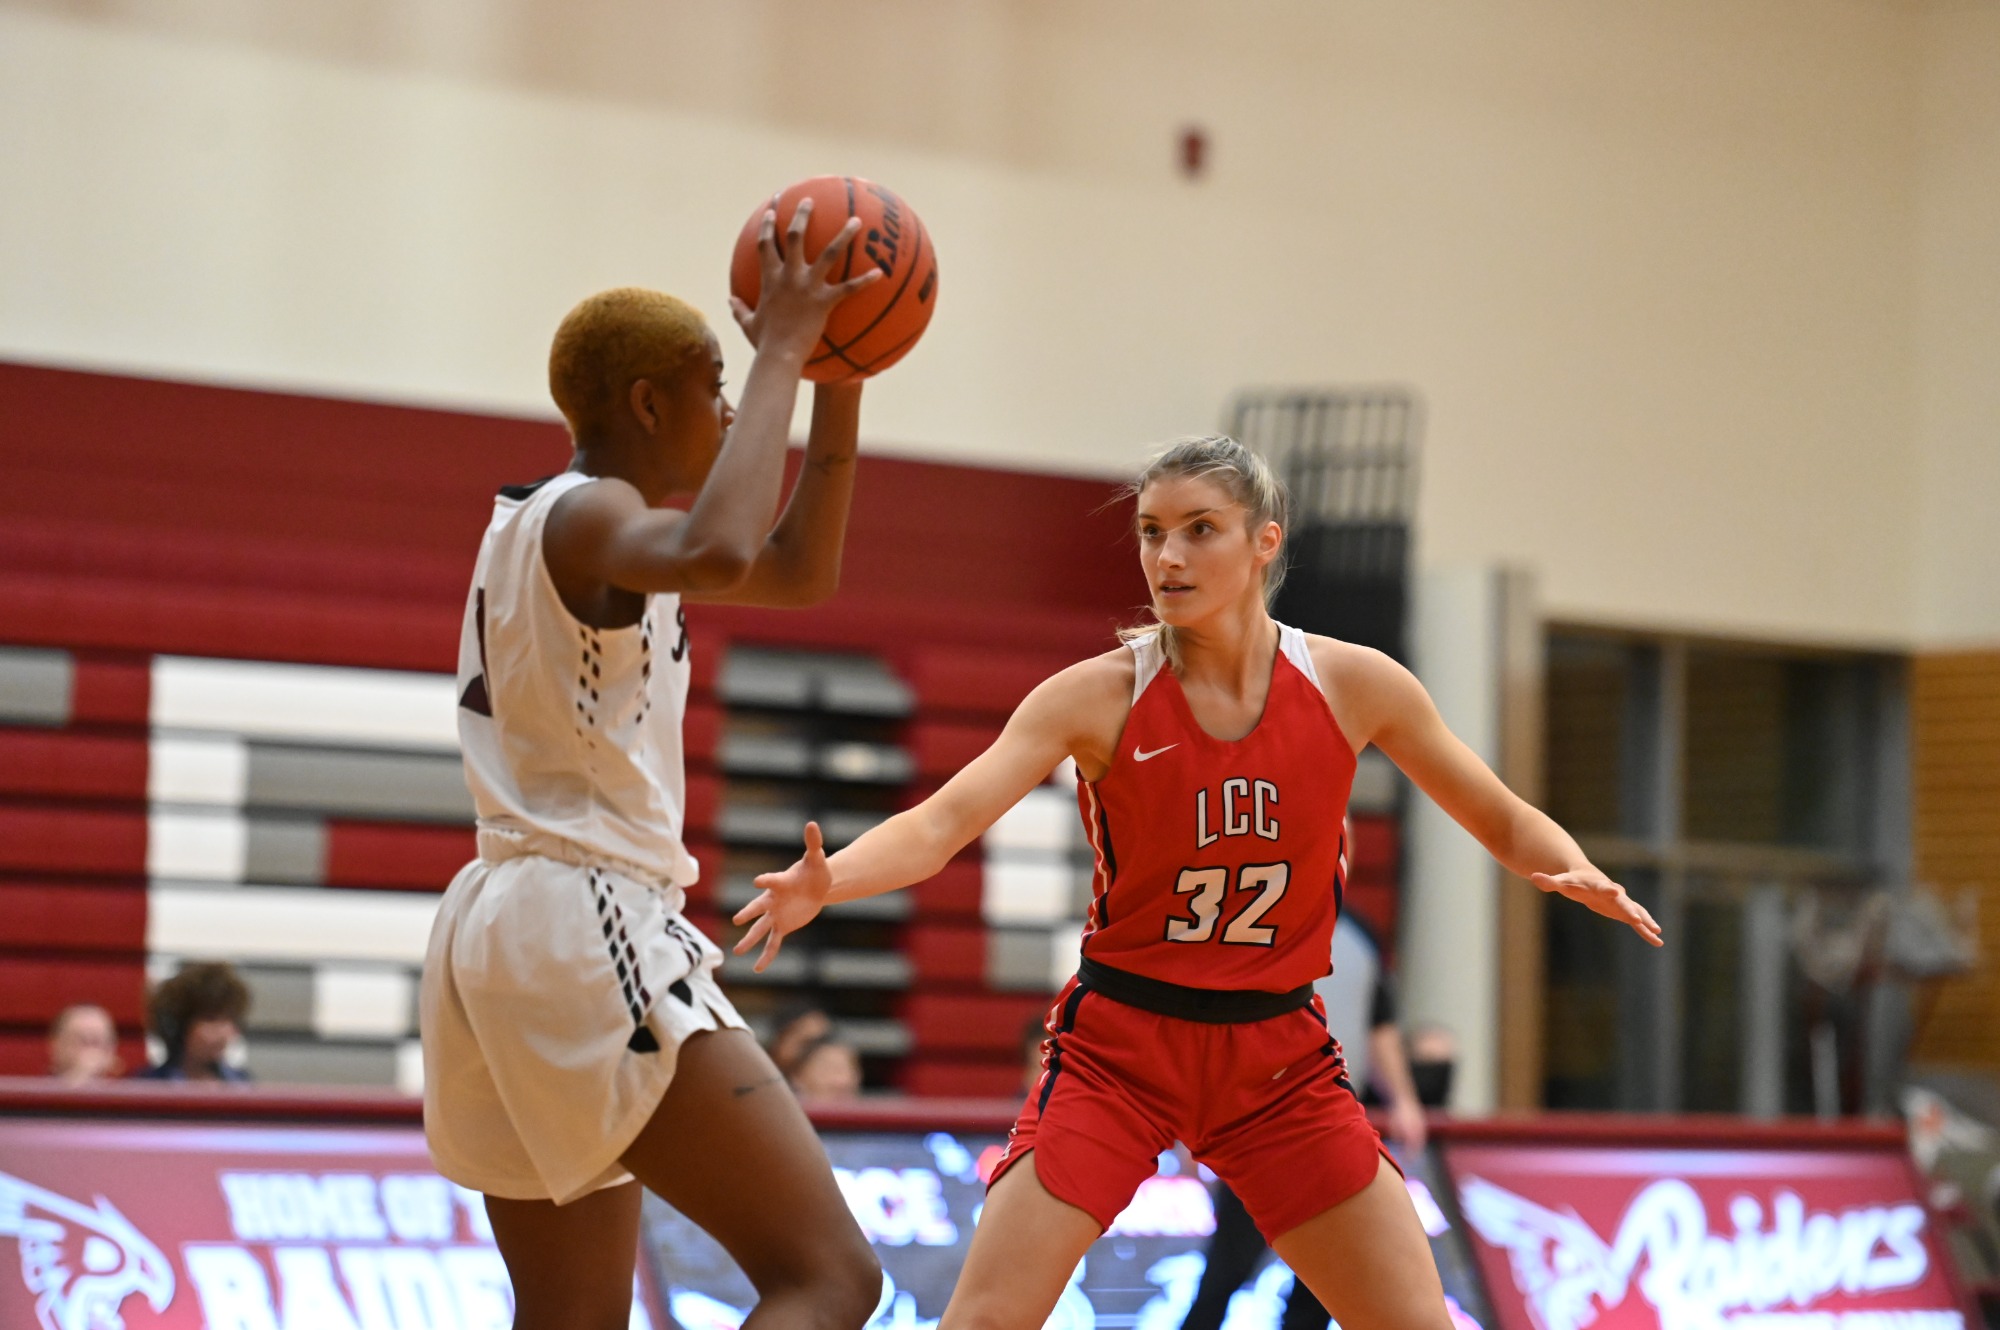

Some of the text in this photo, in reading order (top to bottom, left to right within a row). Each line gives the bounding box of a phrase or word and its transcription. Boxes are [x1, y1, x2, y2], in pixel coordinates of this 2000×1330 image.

[1196, 776, 1280, 850] LCC
[1163, 860, 1291, 948] 32
[220, 1173, 387, 1240] HOME
[381, 1173, 454, 1240] OF
[183, 1244, 516, 1330] RAIDE
[1612, 1177, 1928, 1330] Raiders
